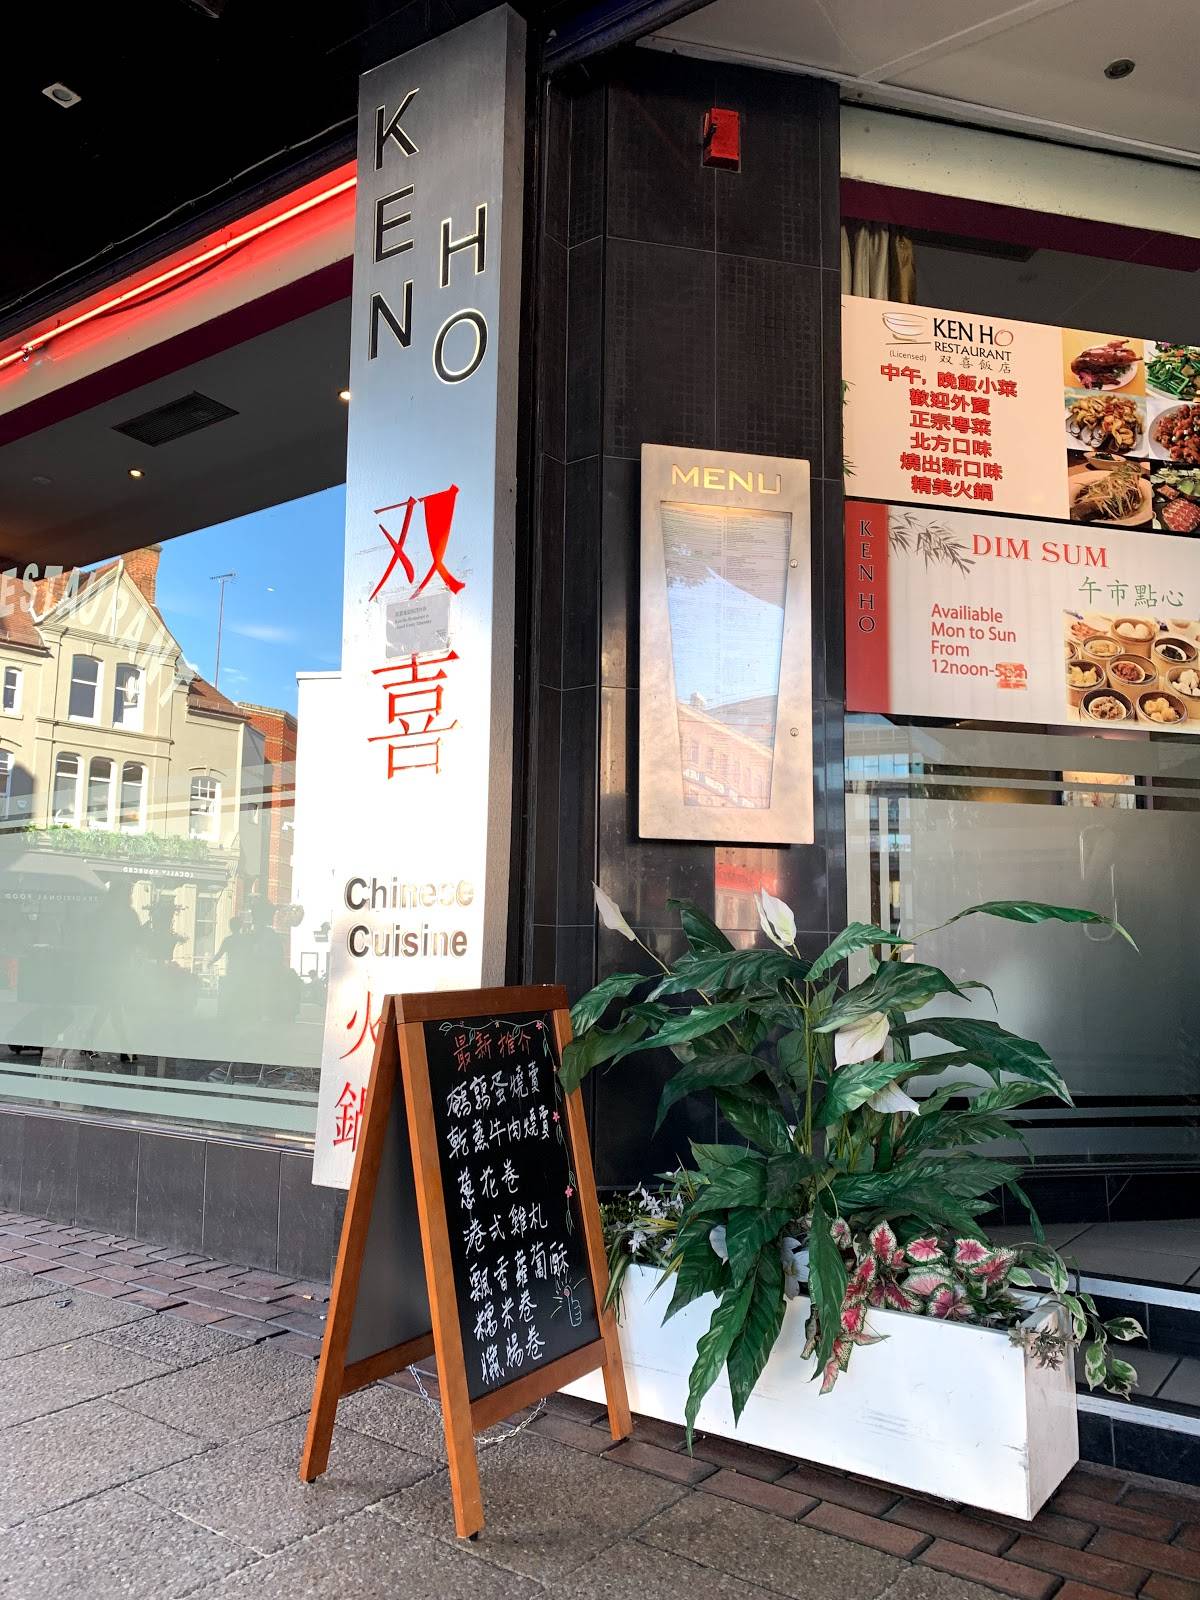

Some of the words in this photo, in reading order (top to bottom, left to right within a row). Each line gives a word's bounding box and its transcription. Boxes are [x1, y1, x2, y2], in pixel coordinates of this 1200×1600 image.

[368, 88, 420, 362] KEN
[432, 202, 488, 385] HO
[933, 318, 973, 342] KEN
[980, 326, 1014, 347] HO
[889, 349, 927, 362] (Licensed)
[934, 341, 1012, 362] RESTAURANT
[909, 388, 991, 415] 歡迎外賣
[910, 432, 992, 458] 北方口味
[671, 464, 782, 495] MENU
[900, 452, 1003, 481] 燒出新口味
[911, 475, 994, 501] 精美火鍋
[858, 519, 874, 583] KEN
[972, 534, 1032, 561] DIM
[1041, 541, 1109, 568] SUM
[1078, 575, 1184, 608] 午市點心
[857, 592, 876, 634] HO
[931, 622, 965, 639] Mon
[969, 624, 984, 640] to
[988, 625, 1017, 643] Sun
[932, 640, 970, 657] From
[345, 877, 475, 910] Chinese
[347, 924, 468, 958] Cuisine
[453, 1030, 532, 1073] 最新推介
